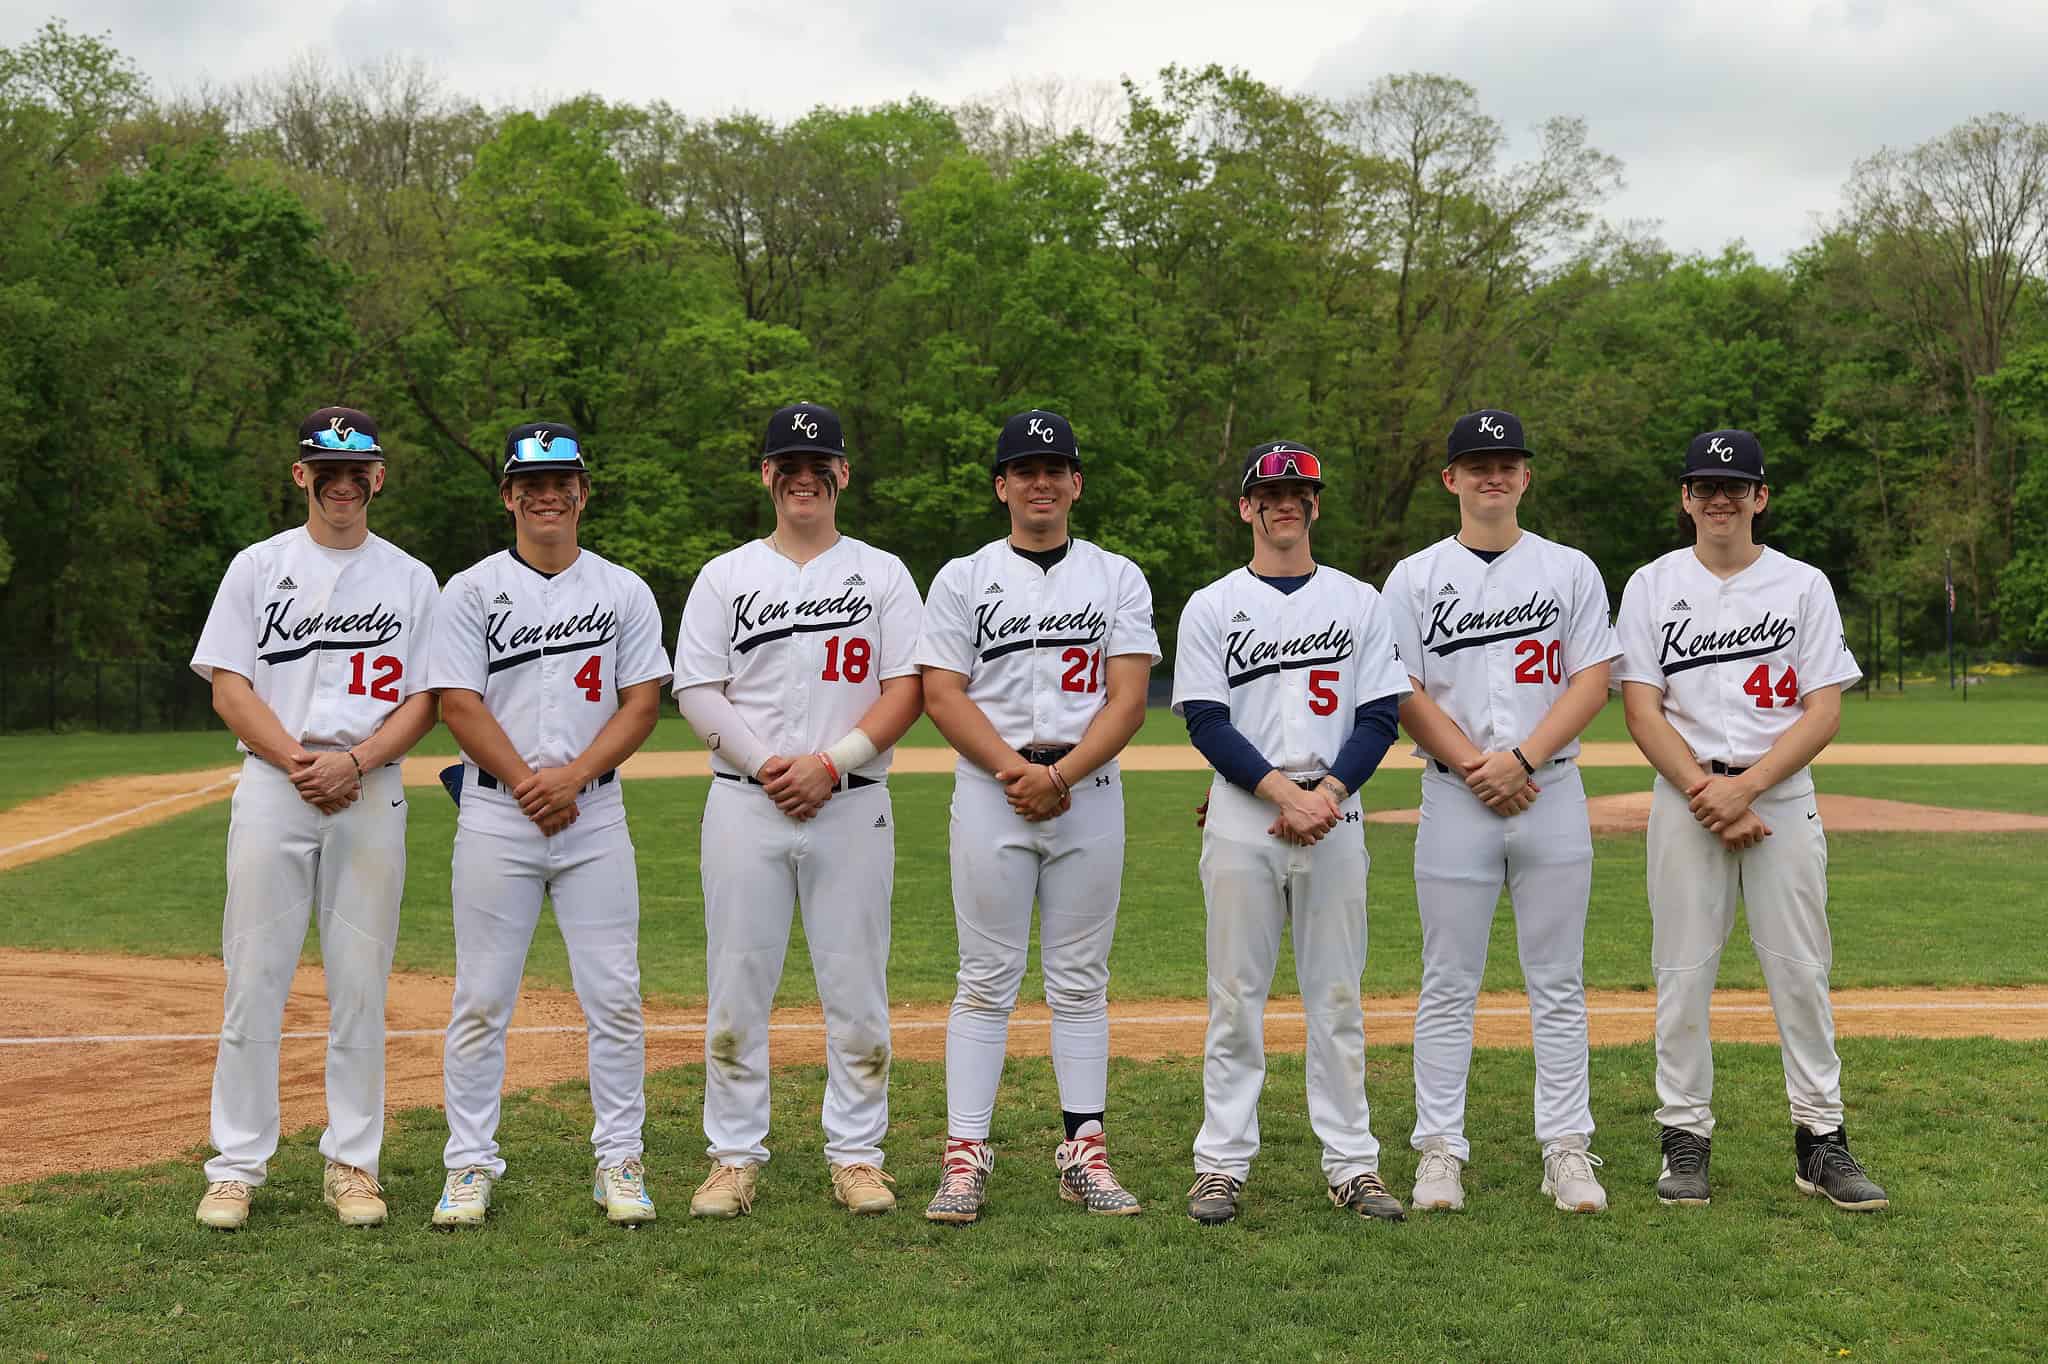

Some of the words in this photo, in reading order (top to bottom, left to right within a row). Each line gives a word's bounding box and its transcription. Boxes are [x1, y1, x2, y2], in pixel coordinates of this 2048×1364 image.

[257, 597, 402, 650] Kennedy
[486, 602, 617, 653] Kennedy
[731, 587, 873, 644] Kennedy
[973, 600, 1107, 649] Kennedy
[1423, 590, 1560, 646] Kennedy
[1659, 611, 1797, 665] Kennedy
[821, 635, 871, 684] 18
[1061, 648, 1100, 693] 21
[1225, 620, 1354, 671] Kennedy
[1515, 639, 1561, 684] 20
[348, 651, 403, 703] 12
[574, 655, 602, 702] 4
[1309, 670, 1339, 716] 5
[1743, 664, 1797, 708] 44
